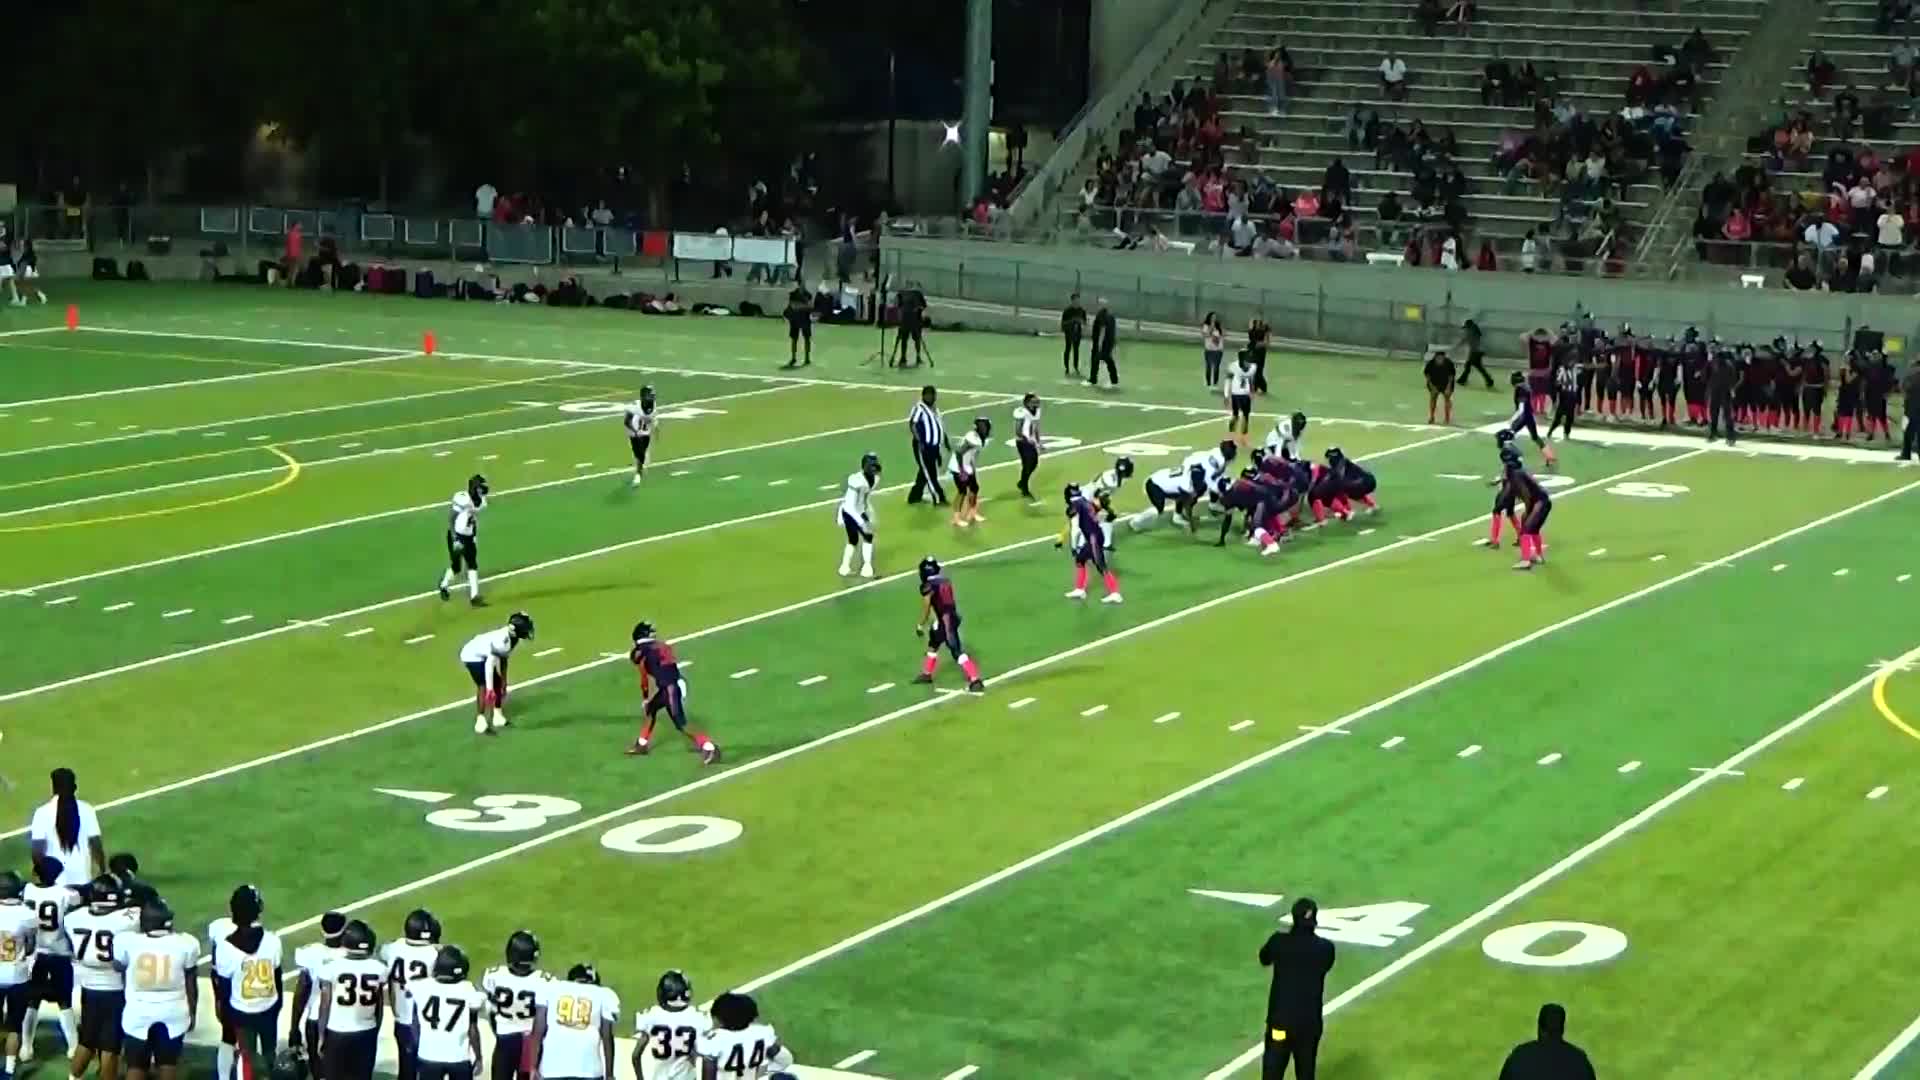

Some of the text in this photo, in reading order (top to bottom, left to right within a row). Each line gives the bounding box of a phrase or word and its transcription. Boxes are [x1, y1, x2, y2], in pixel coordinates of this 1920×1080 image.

[25, 900, 59, 931] 9
[73, 928, 114, 962] 79
[135, 953, 171, 987] 91
[388, 956, 428, 990] 42
[337, 973, 381, 1006] 35
[493, 986, 536, 1020] 23
[422, 995, 466, 1032] 47
[651, 1025, 697, 1060] 33
[724, 1038, 765, 1077] 44
